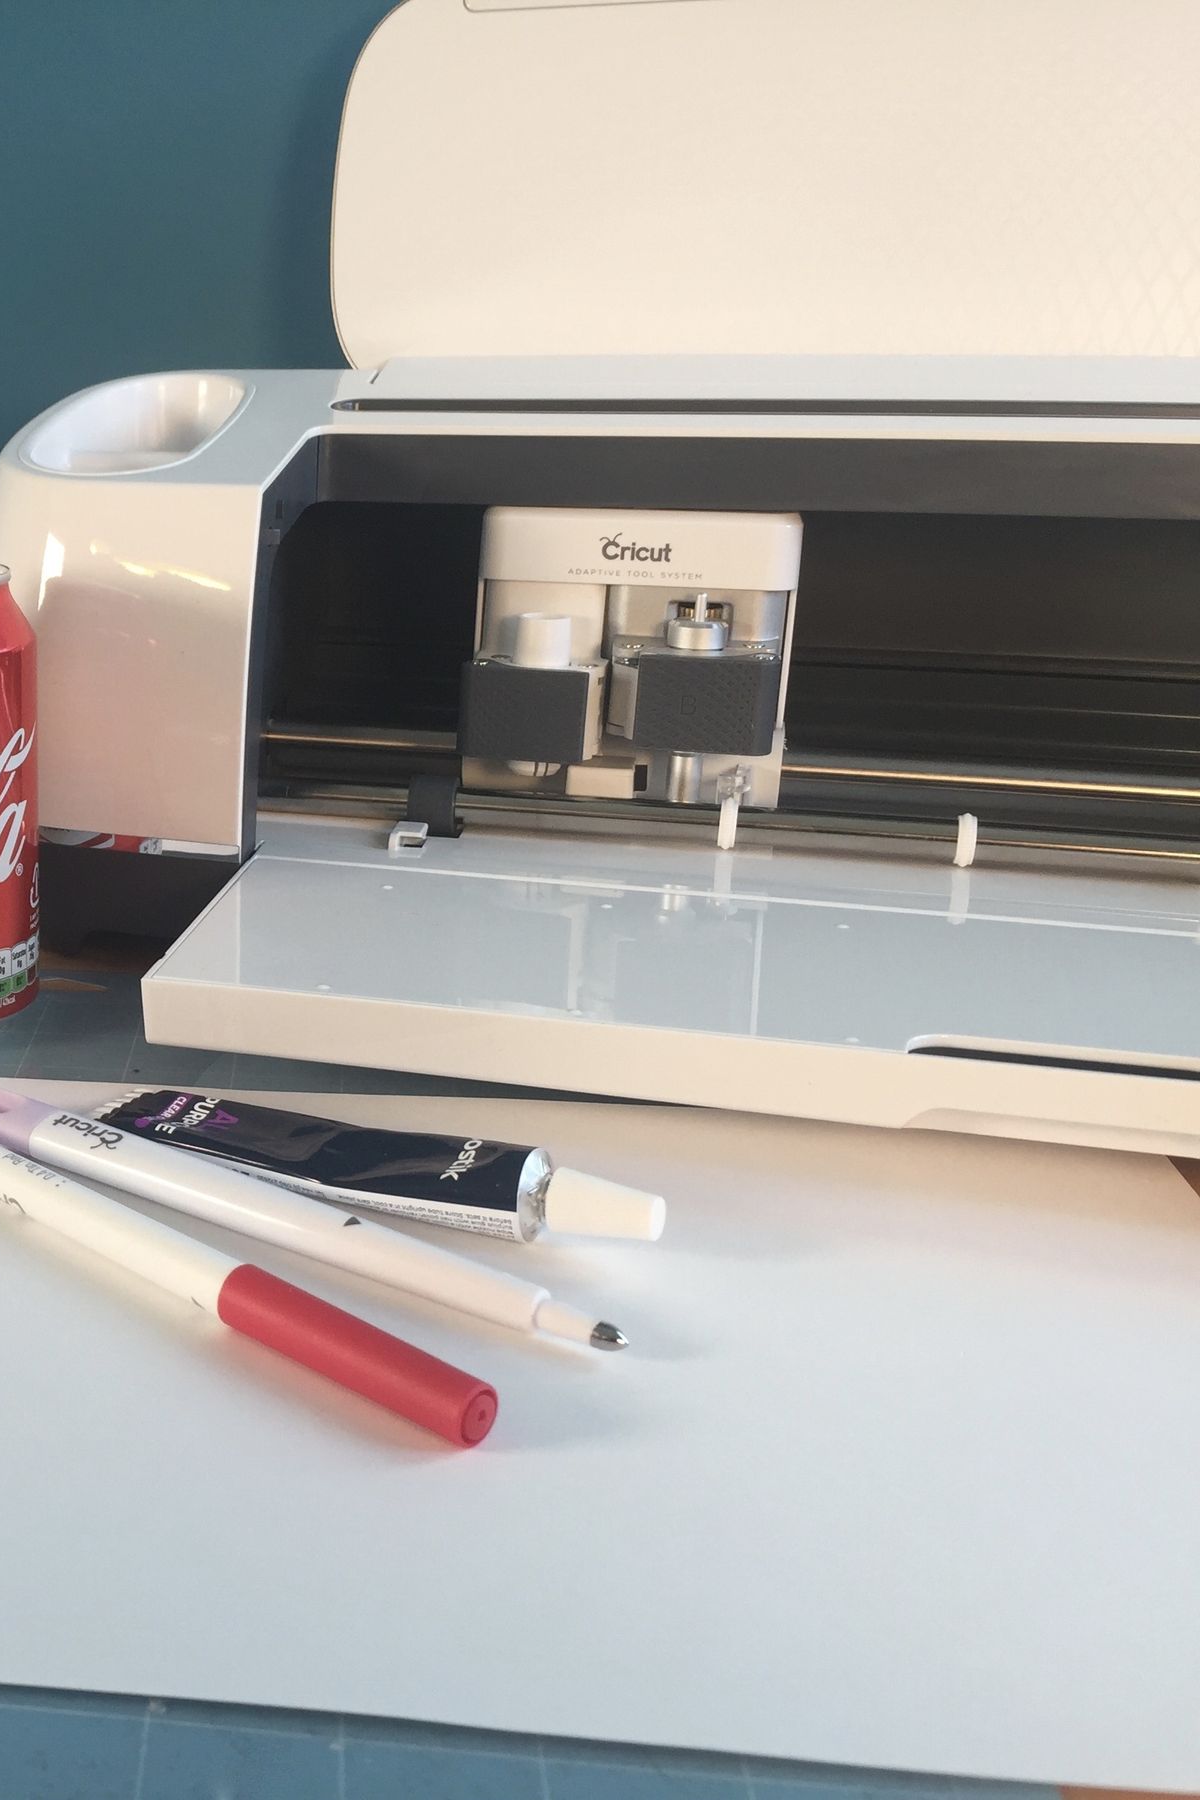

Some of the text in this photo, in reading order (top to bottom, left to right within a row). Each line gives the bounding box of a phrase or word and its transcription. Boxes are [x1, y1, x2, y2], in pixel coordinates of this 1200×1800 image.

[599, 532, 672, 563] Cricut
[567, 567, 703, 581] ADAPTIVE TOOL SYSTEM
[51, 1115, 124, 1150] Cricut
[440, 1140, 483, 1181] ostik
